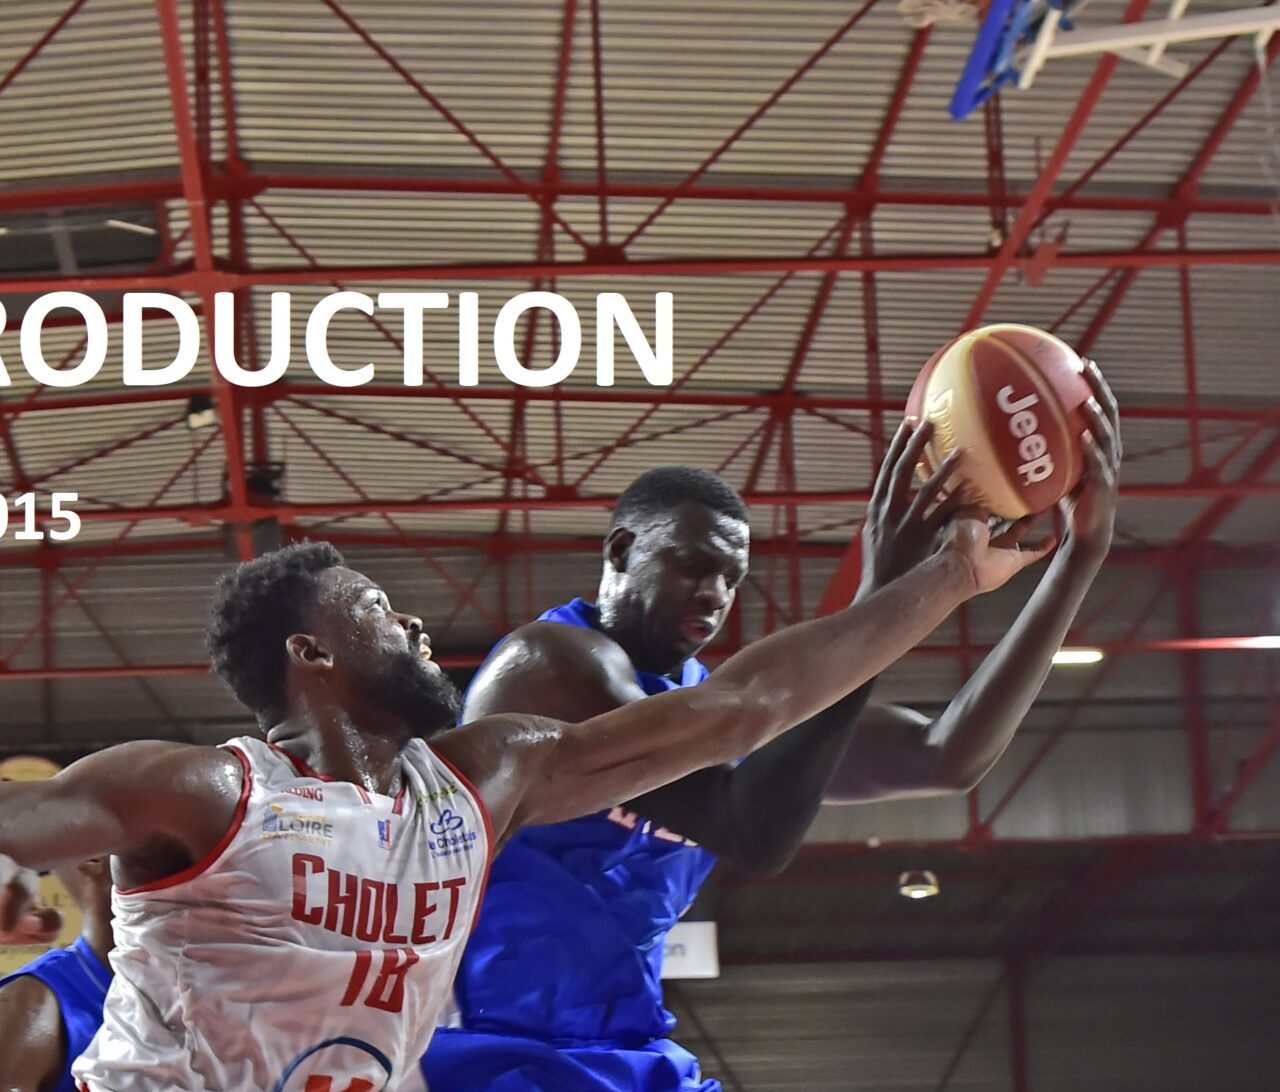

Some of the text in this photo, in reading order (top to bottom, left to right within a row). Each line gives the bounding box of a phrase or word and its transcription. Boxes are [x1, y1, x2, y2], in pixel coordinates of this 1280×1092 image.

[996, 384, 1056, 487] Jeep
[290, 852, 467, 945] CHOLET
[340, 947, 420, 1014] 18
